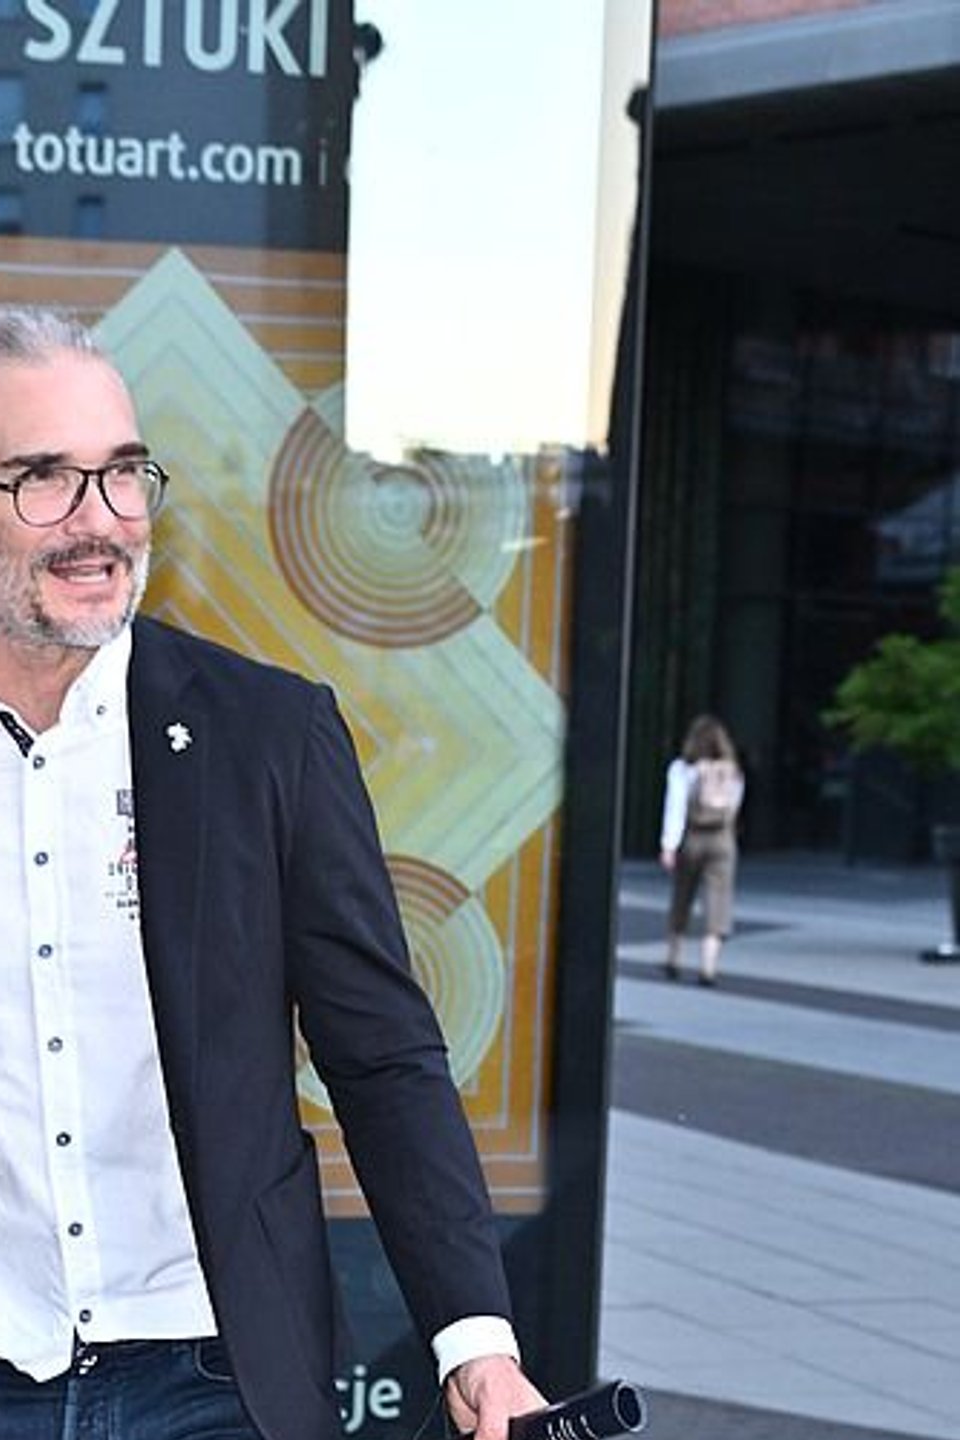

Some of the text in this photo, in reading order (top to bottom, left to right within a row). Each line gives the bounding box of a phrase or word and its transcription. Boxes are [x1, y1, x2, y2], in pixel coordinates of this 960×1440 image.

[24, 0, 328, 77] SZTUKI
[13, 121, 302, 186] totuart.com
[334, 1364, 403, 1433] je
